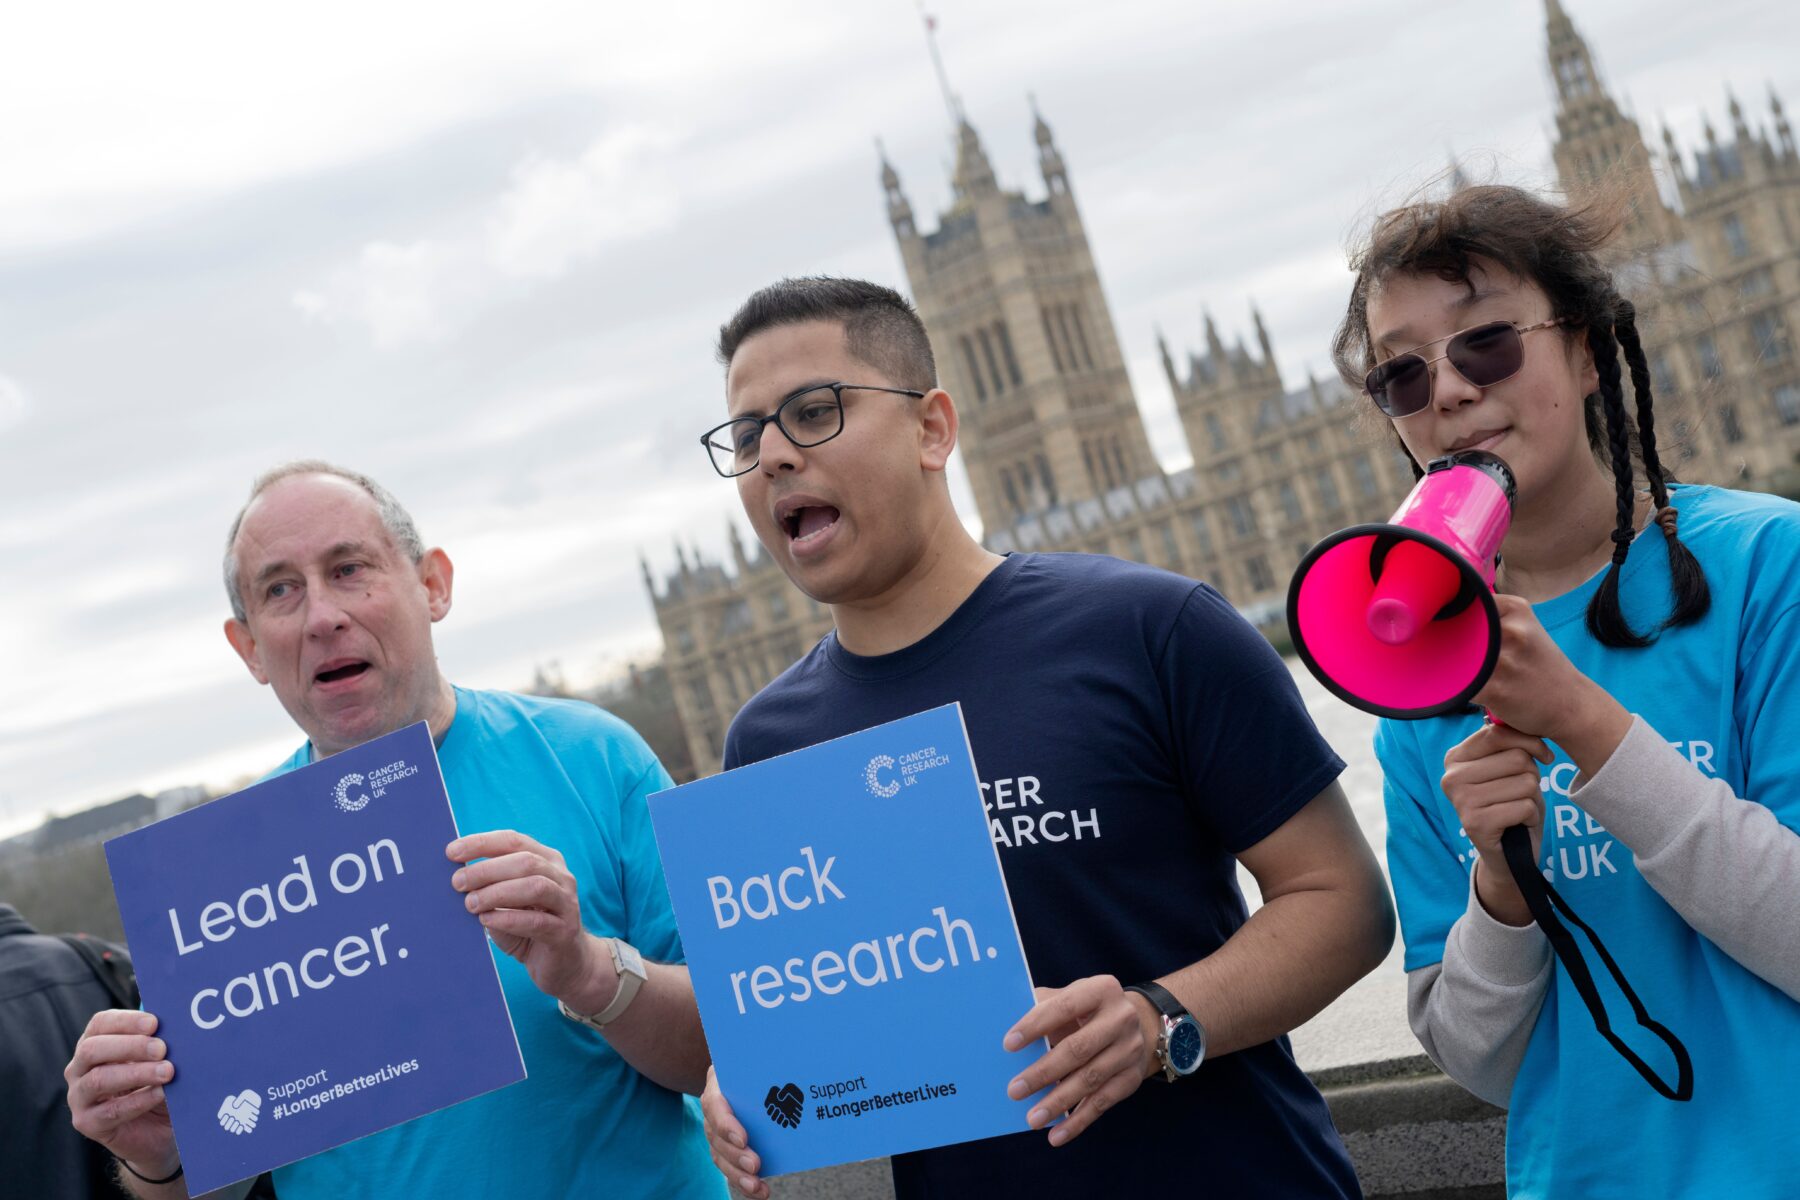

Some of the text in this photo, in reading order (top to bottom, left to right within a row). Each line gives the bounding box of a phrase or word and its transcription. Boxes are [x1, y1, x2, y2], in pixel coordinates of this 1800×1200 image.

[368, 760, 406, 780] CANCER
[898, 746, 937, 765] CANCER
[901, 754, 950, 776] RESEARCH
[370, 765, 418, 789] RESEARCH
[372, 787, 387, 799] UK
[903, 775, 918, 787] UK
[1559, 840, 1618, 880] UK
[168, 838, 405, 956] Lead on
[706, 846, 846, 929] Back
[190, 923, 409, 1030] cancer.
[730, 906, 998, 1015] research.
[267, 1068, 328, 1102] Support
[273, 1058, 419, 1120] #LongerBetterLives
[809, 1076, 867, 1105] Support
[815, 1081, 957, 1121] #LongerBetterLives
